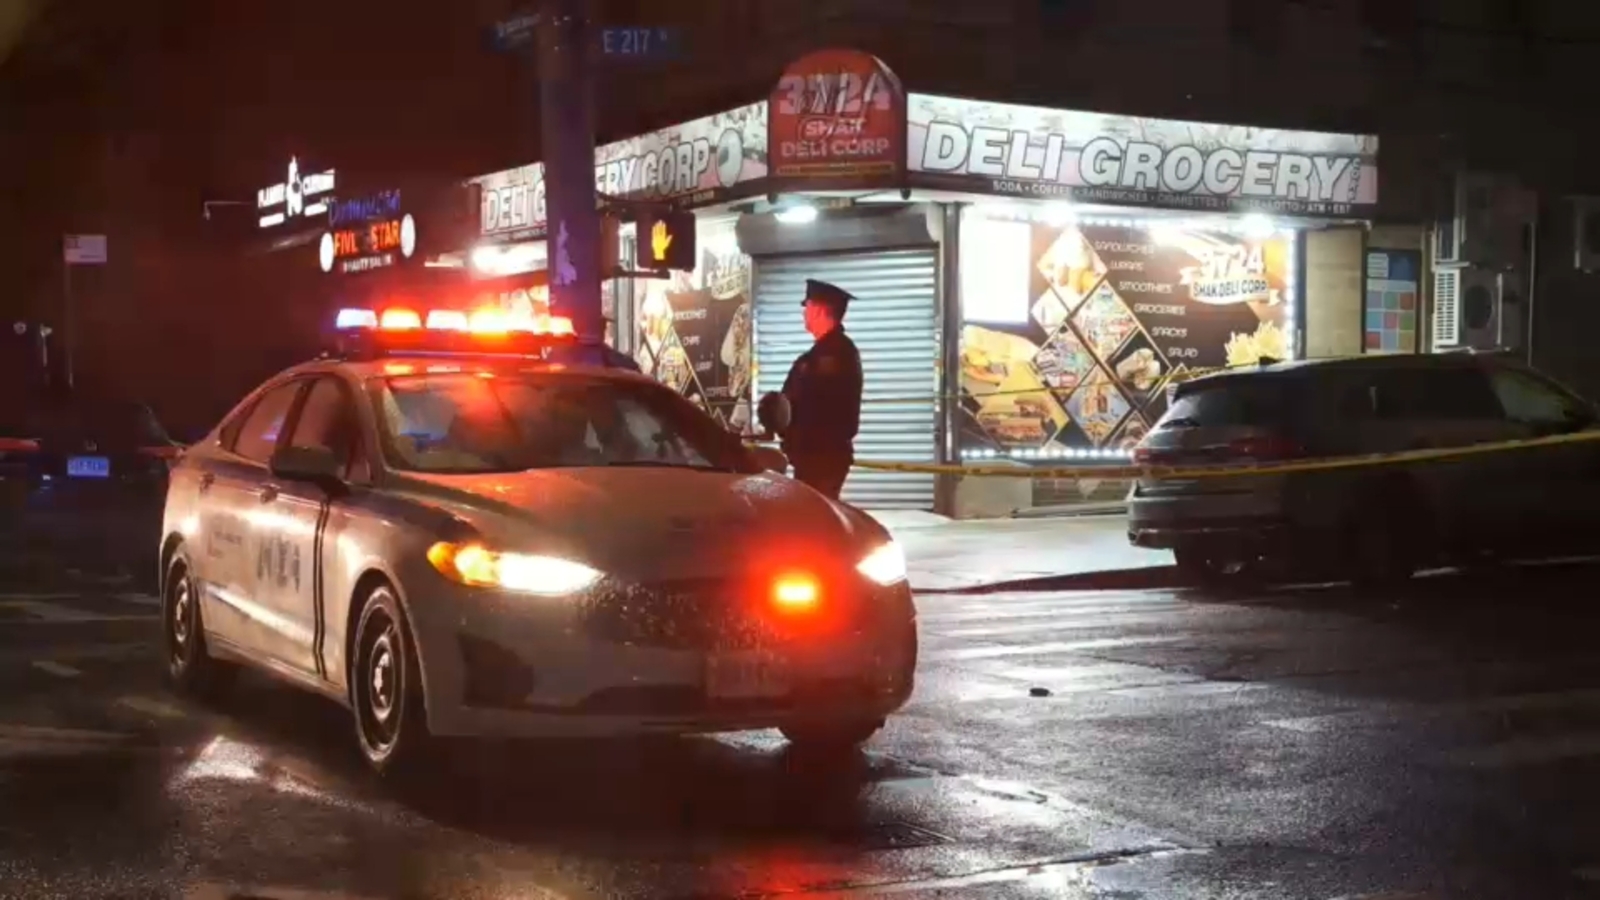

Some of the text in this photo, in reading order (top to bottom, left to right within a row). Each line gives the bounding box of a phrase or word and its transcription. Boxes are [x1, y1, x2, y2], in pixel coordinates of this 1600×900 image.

[603, 29, 614, 53] E
[621, 29, 650, 53] 217
[781, 137, 890, 157] DELI CORP
[921, 120, 1352, 201] DELI GROCERY
[485, 184, 528, 231] DELI
[640, 138, 709, 196] CORP
[993, 180, 1023, 193] SODA
[1307, 202, 1325, 213] ATM
[1332, 203, 1352, 214] EBT
[370, 220, 400, 251] STAR
[1219, 280, 1240, 297] DELI
[1241, 279, 1267, 294] CORP
[1151, 327, 1188, 338] SNACKS
[1167, 346, 1199, 358] SALAD
